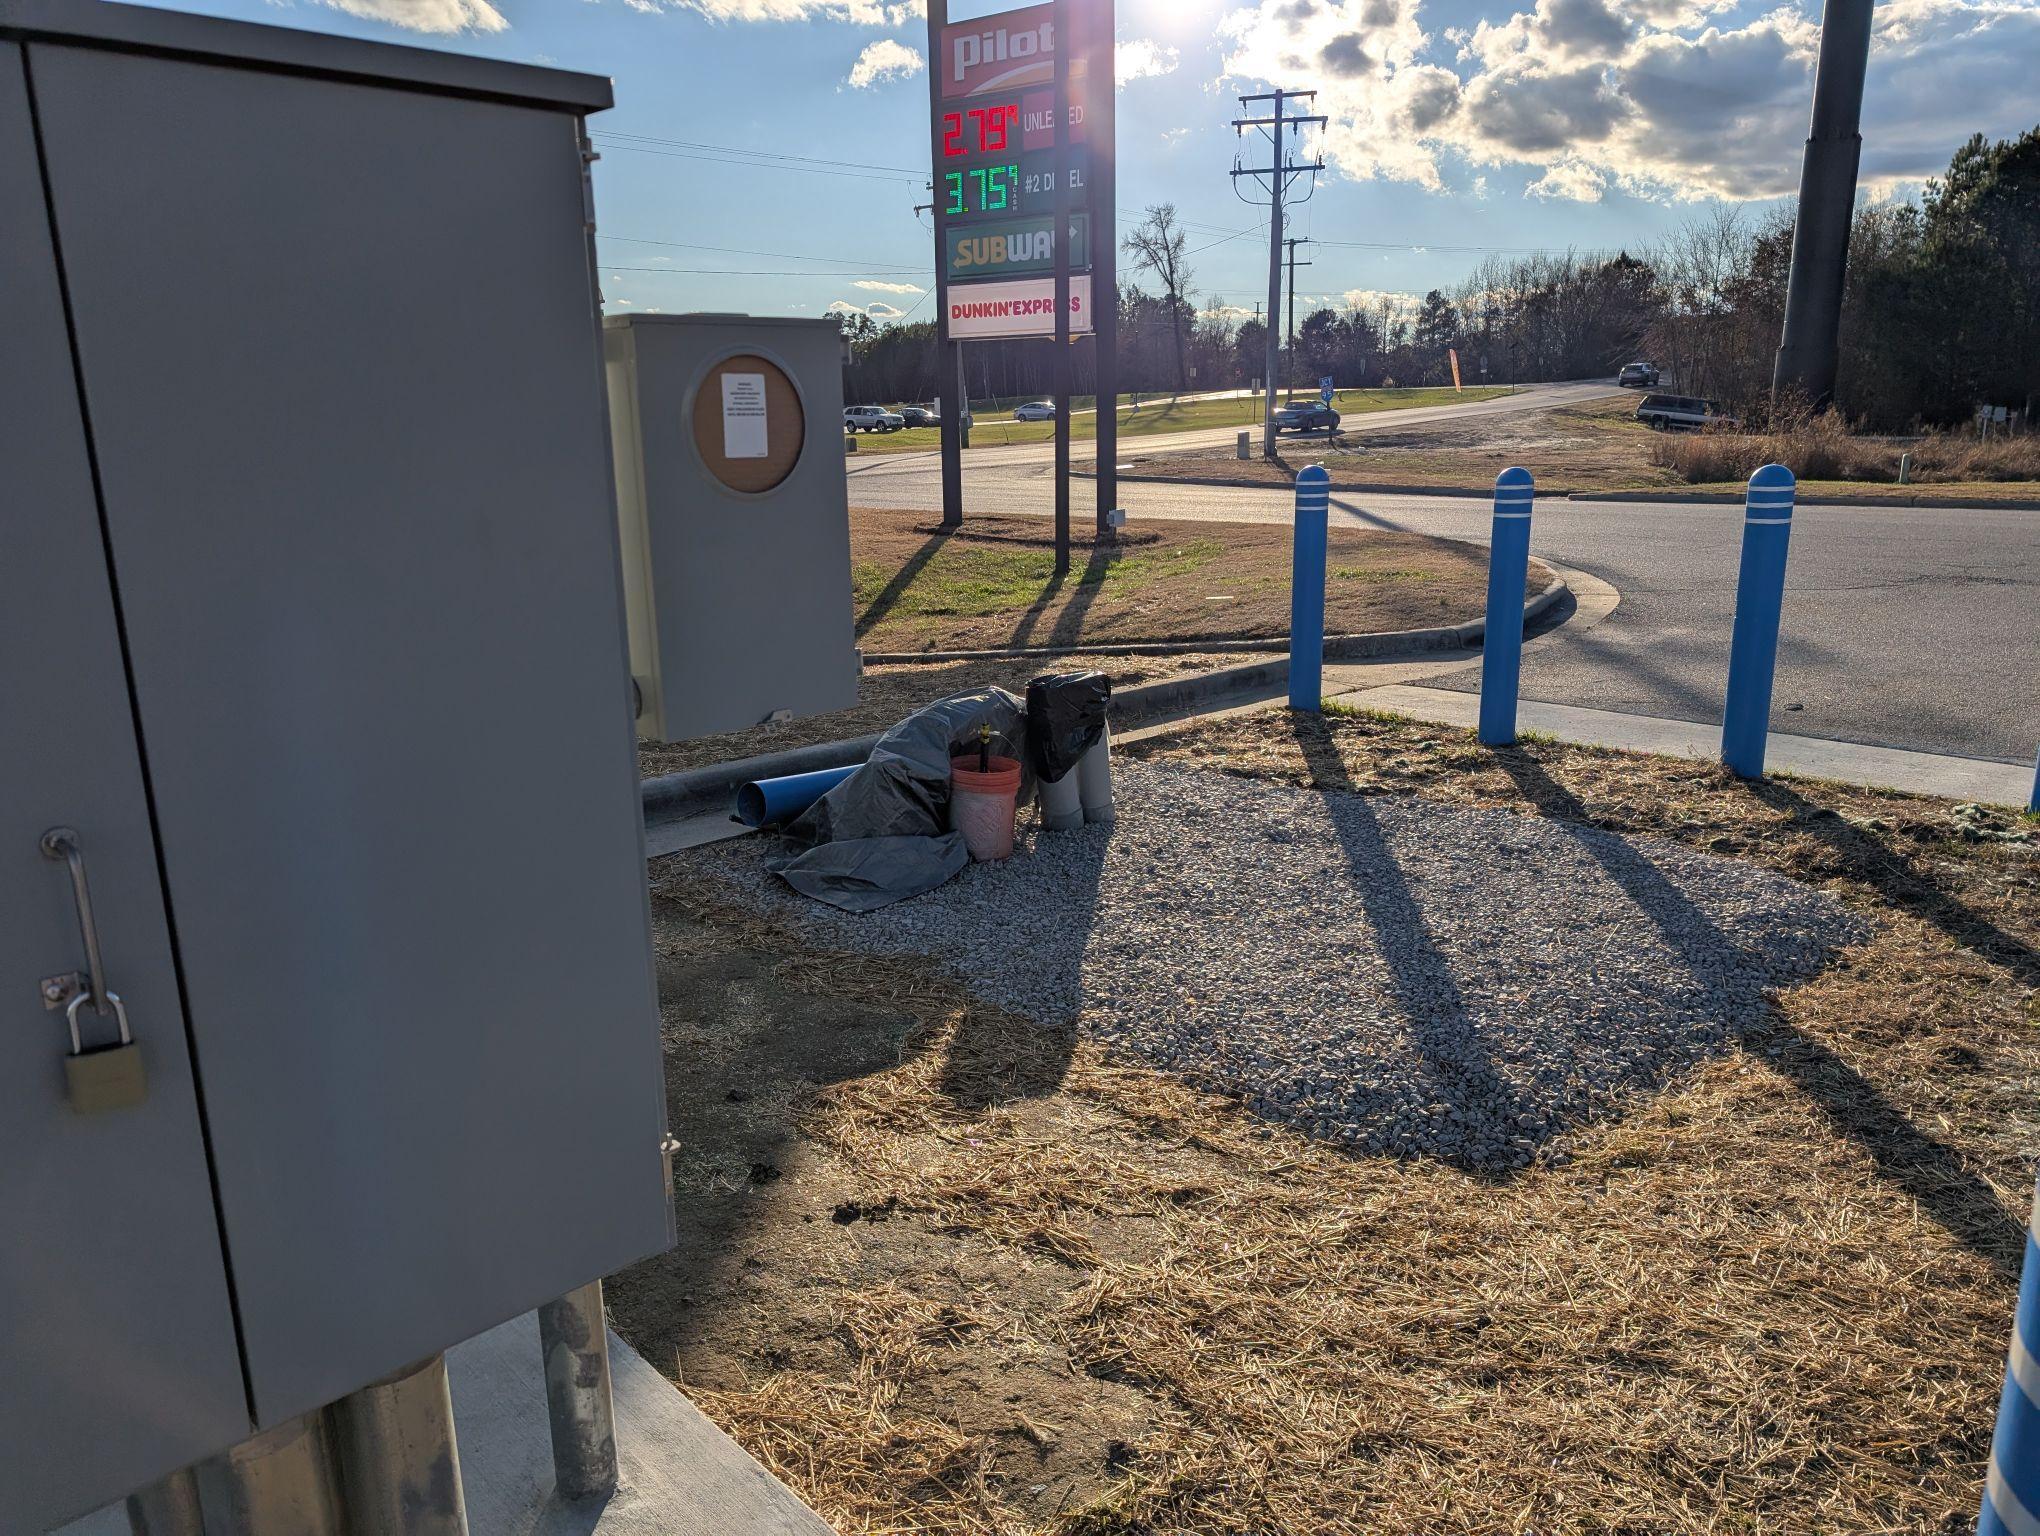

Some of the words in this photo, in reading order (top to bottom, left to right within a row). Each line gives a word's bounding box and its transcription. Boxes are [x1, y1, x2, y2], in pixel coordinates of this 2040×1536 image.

[1024, 105, 1084, 131] UNLEED
[1025, 174, 1040, 193] #2
[1044, 169, 1084, 191] DIEL
[953, 231, 1055, 268] SUBWA
[1013, 296, 1080, 316] EXPRS
[1322, 390, 1332, 399] 95
